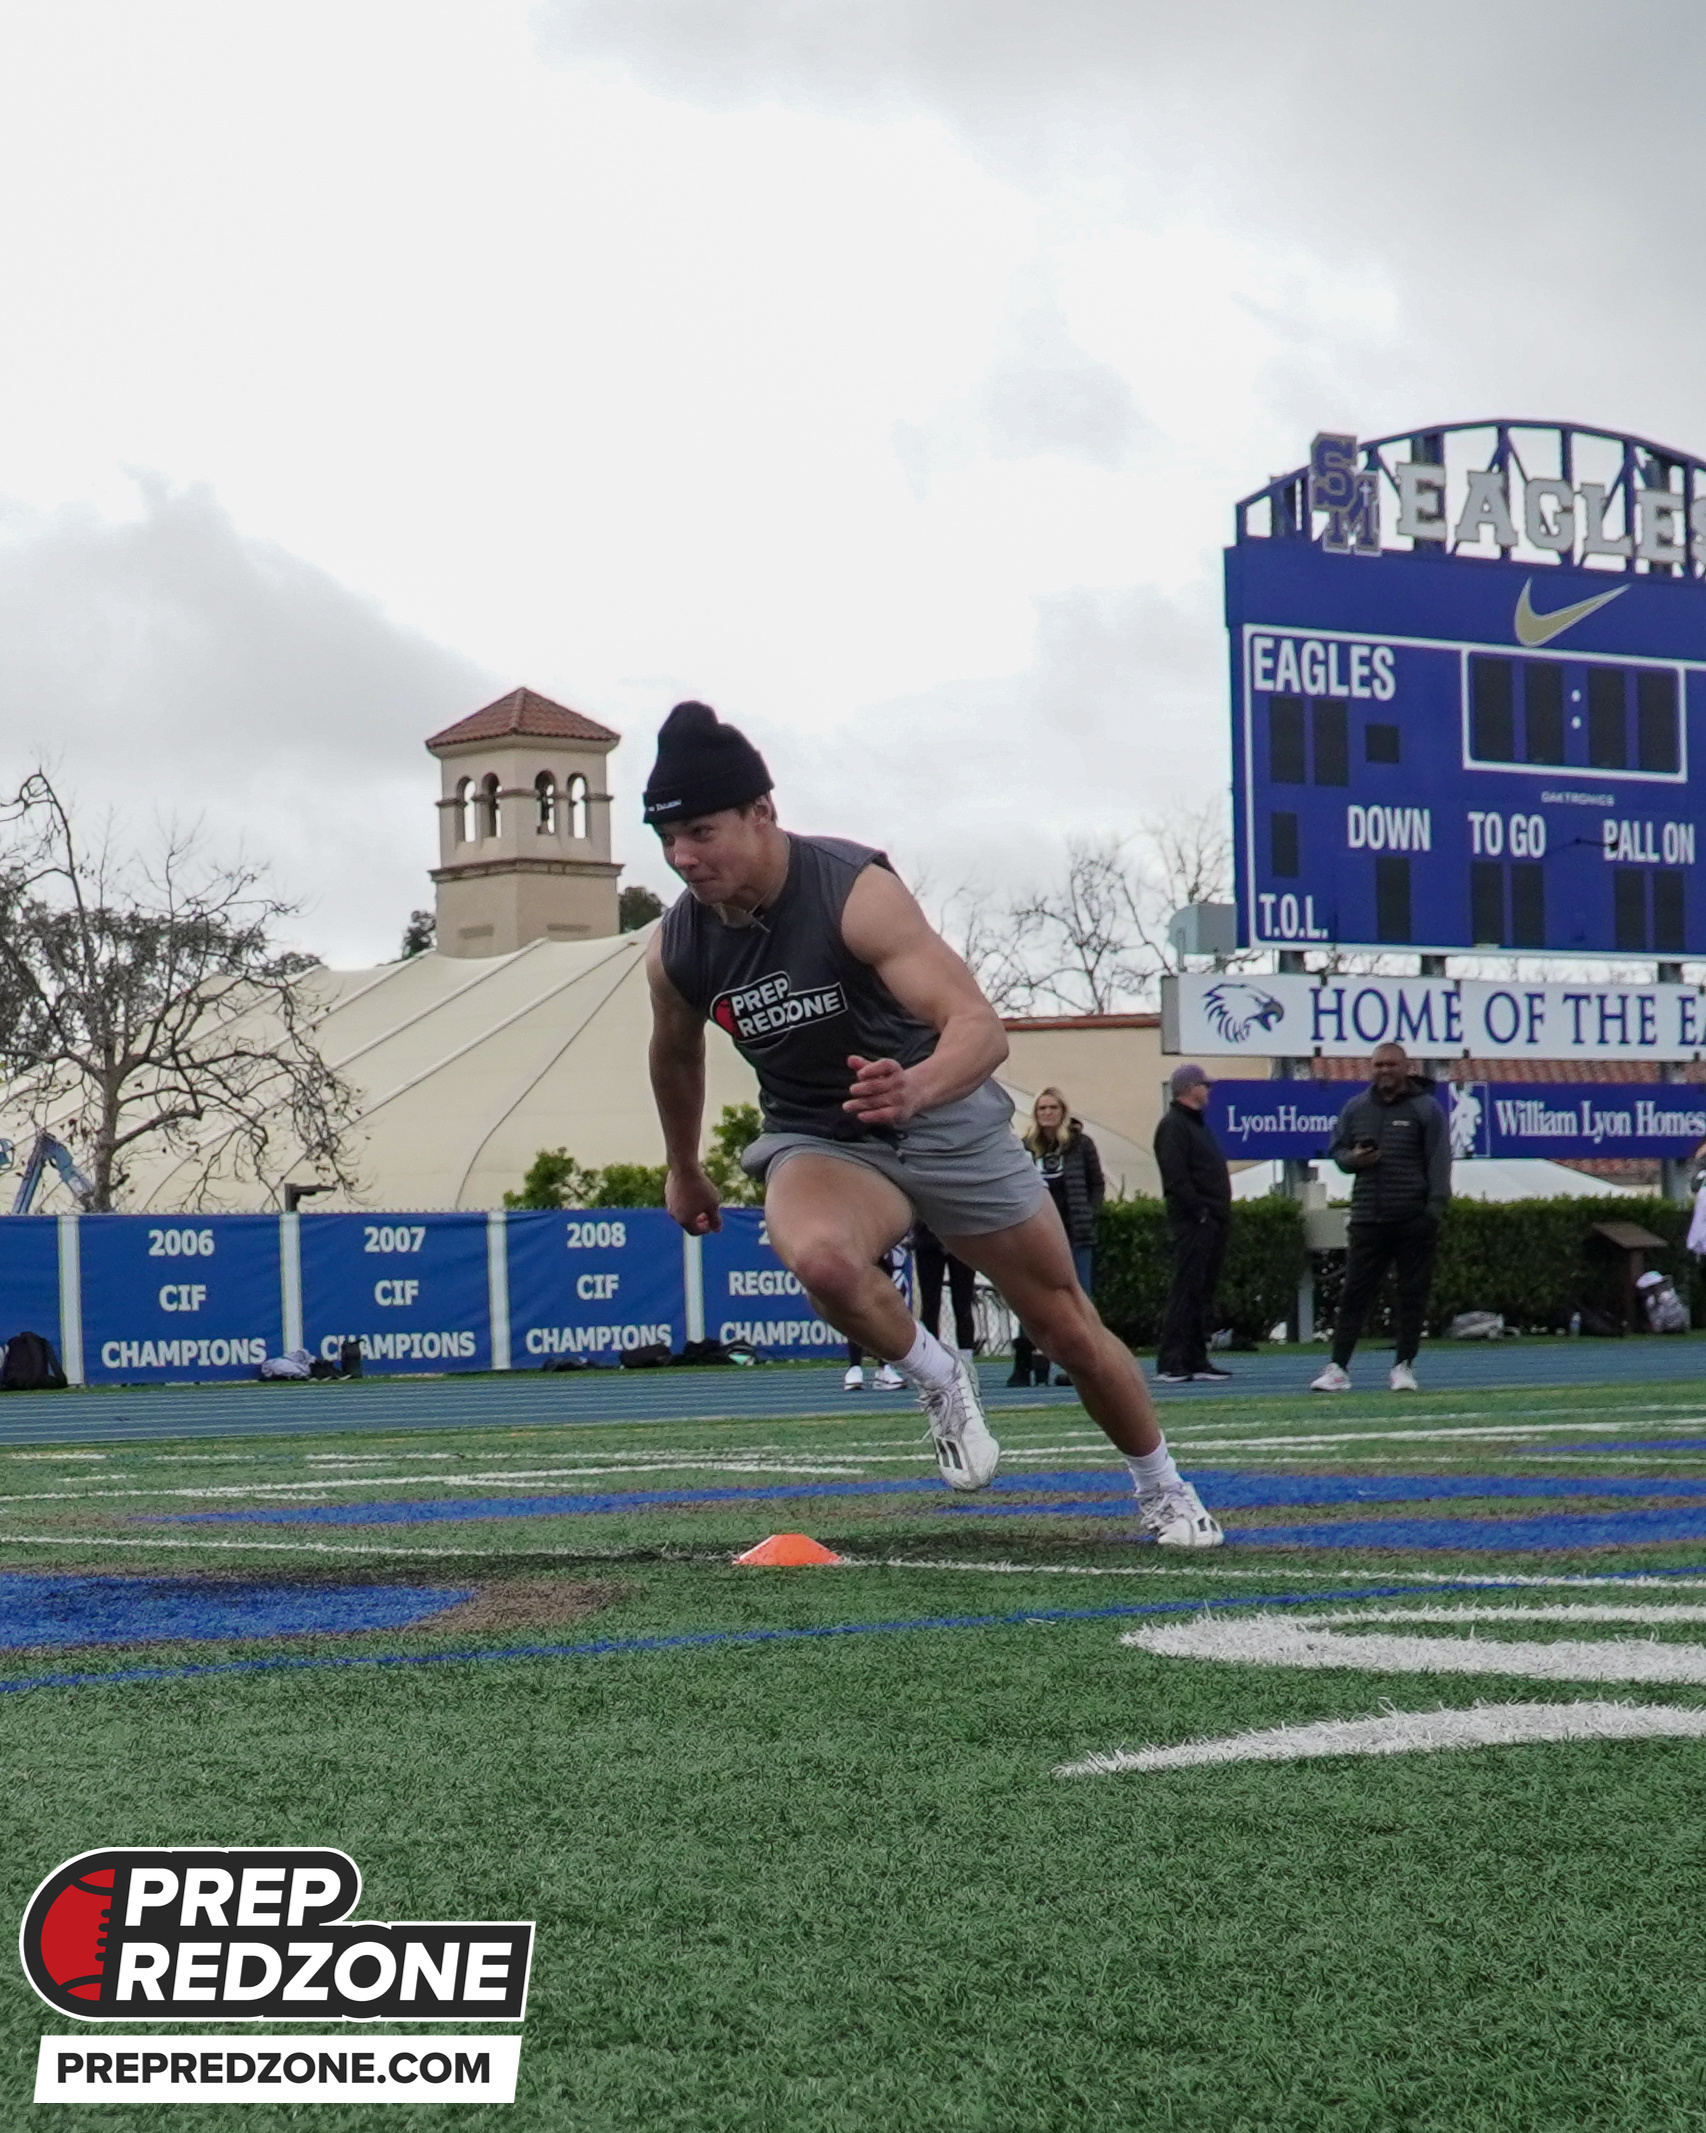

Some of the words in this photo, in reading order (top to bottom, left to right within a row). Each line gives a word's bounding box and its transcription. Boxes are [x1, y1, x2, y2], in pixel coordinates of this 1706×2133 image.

[1252, 638, 1396, 701] EAGLES
[1348, 805, 1431, 852] DOWN
[1468, 812, 1502, 856] TO
[1509, 813, 1546, 859] GO
[1663, 821, 1695, 865] ON
[1259, 894, 1328, 940] T.O.L.
[731, 977, 789, 1017] PREP
[737, 991, 841, 1037] REDZONE
[1309, 987, 1464, 1042] HOME
[1484, 990, 1545, 1044] OF
[1562, 992, 1657, 1045] THE
[1677, 995, 1706, 1045] E
[1227, 1104, 1338, 1142] LyonHome
[1495, 1100, 1579, 1137] William
[1580, 1100, 1633, 1144] Lyon
[1634, 1100, 1706, 1137] Homes
[148, 1229, 215, 1257] 2006
[364, 1226, 426, 1253] 2007
[566, 1222, 626, 1249] 2008
[159, 1284, 207, 1312] CIF
[374, 1279, 419, 1307] CIF
[576, 1274, 619, 1300] CIF
[729, 1271, 808, 1296] REGIO
[525, 1323, 673, 1354] CHAMPIONS
[720, 1320, 848, 1346] CHAMPION
[102, 1338, 267, 1369] CHAMPIONS
